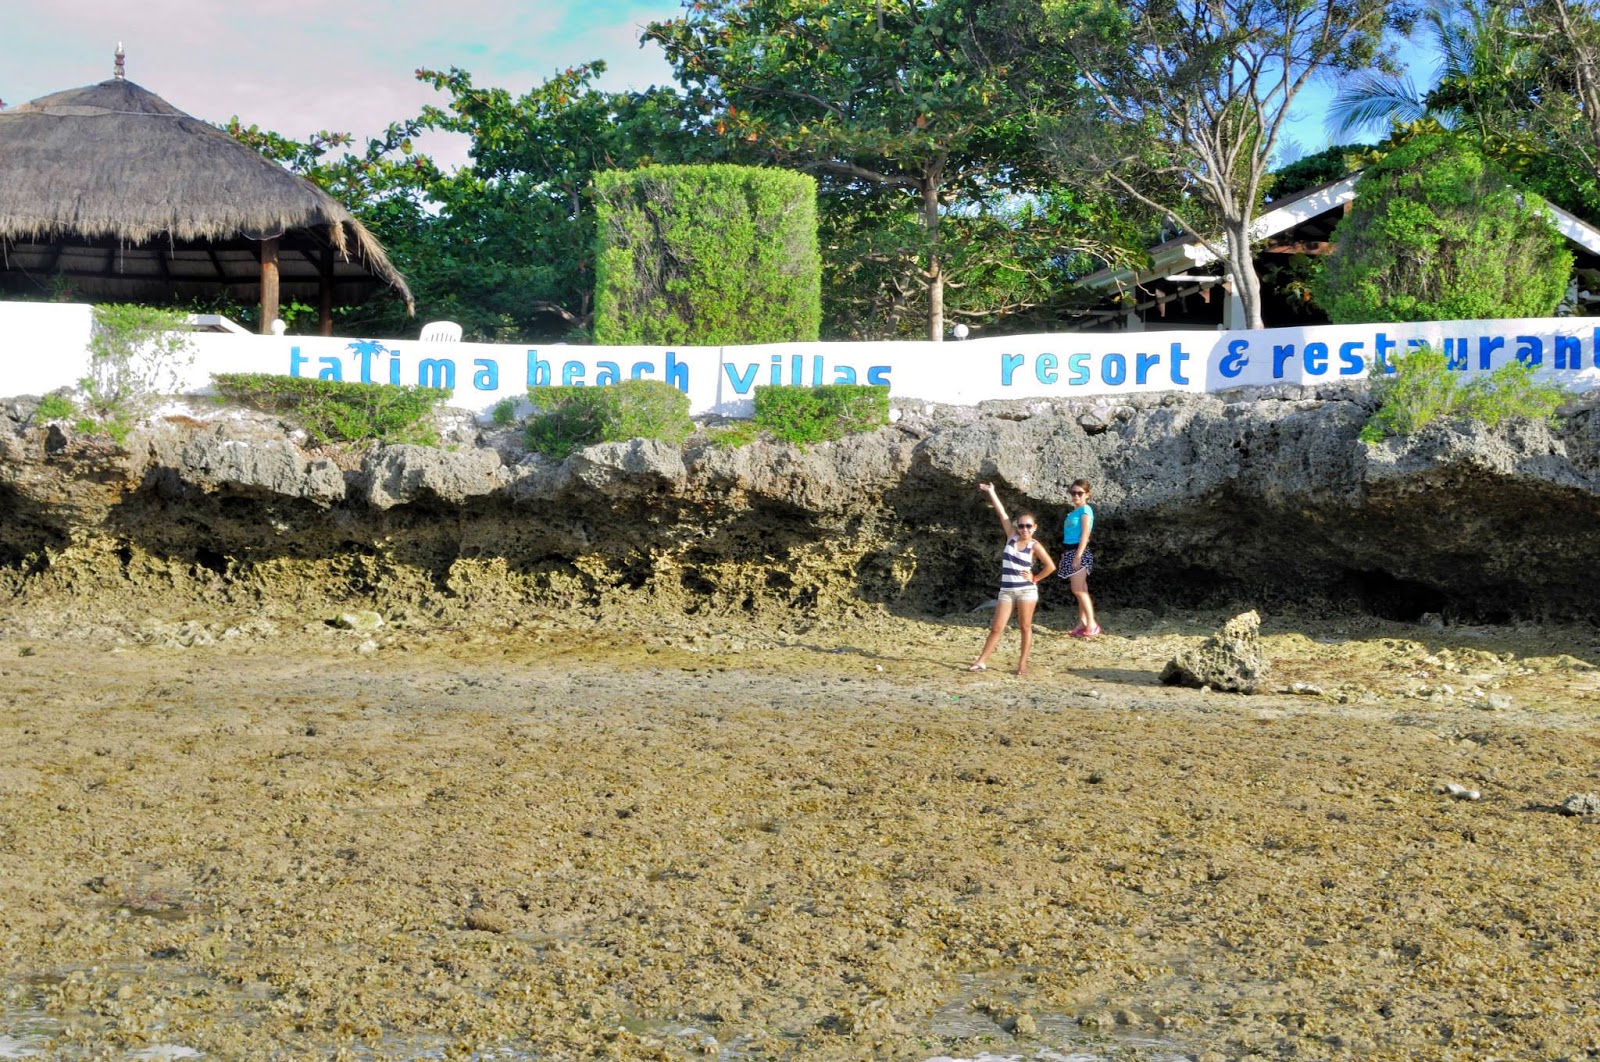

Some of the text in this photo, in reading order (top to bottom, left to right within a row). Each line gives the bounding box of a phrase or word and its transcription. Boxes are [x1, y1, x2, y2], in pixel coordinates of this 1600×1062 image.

[526, 349, 689, 393] beach
[722, 354, 893, 395] villas
[1001, 342, 1190, 386] resort
[1218, 339, 1250, 379] &
